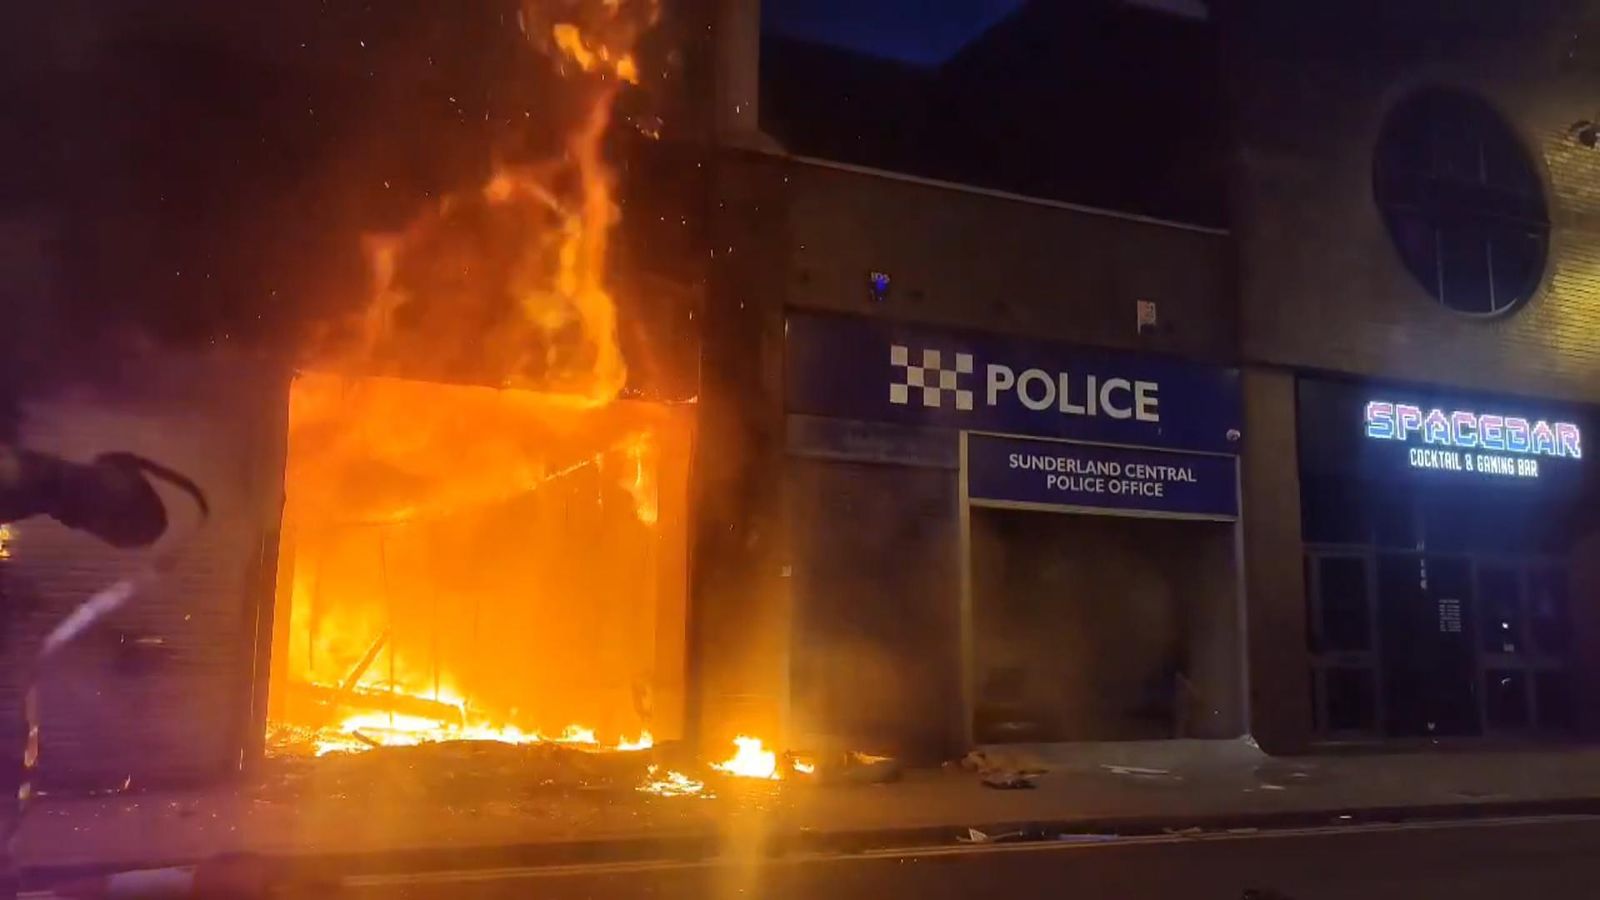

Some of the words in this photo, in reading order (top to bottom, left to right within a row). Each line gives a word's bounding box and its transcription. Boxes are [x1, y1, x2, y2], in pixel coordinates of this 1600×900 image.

[987, 364, 1159, 422] POLICE
[1366, 401, 1582, 458] SPACEBAR
[1009, 454, 1121, 476] SUNDERLAND
[1125, 464, 1197, 482] CENTRAL
[1410, 448, 1462, 471] COCKTAIL
[1465, 453, 1474, 471] &
[1477, 455, 1514, 475] GAMING
[1518, 459, 1538, 477] BAR
[1047, 475, 1105, 493] POLICE
[1109, 480, 1164, 497] OFFICE
